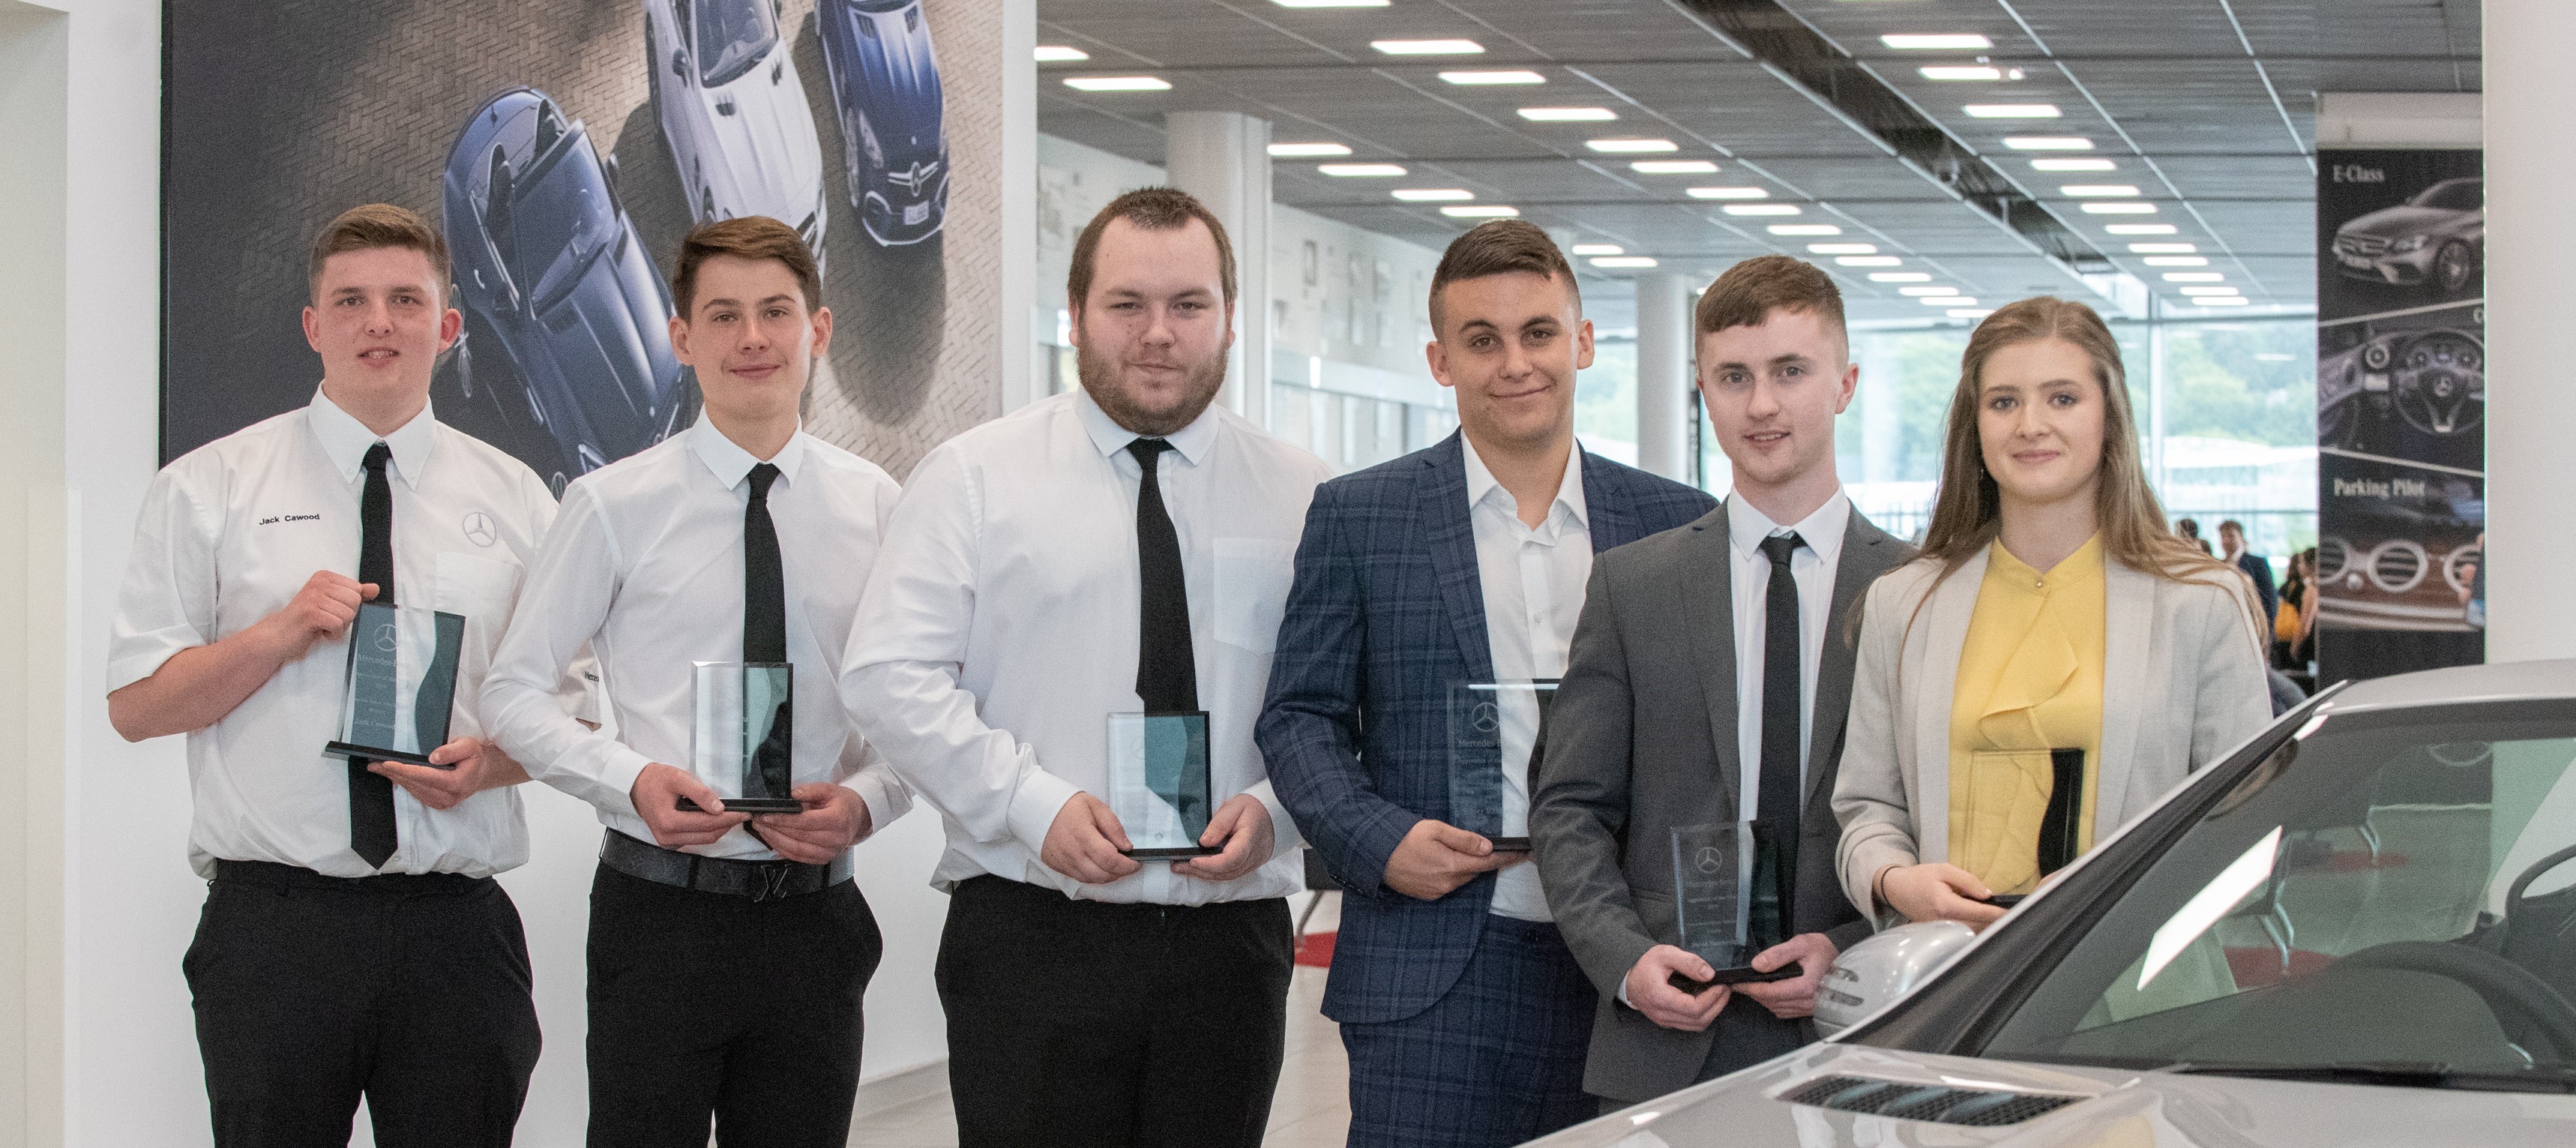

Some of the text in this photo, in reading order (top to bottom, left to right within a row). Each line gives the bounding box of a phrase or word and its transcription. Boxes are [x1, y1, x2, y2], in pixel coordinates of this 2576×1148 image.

[2332, 164, 2386, 183] E-Class
[2334, 478, 2426, 499] Parking Pilot
[259, 513, 320, 525] Jack Cawood
